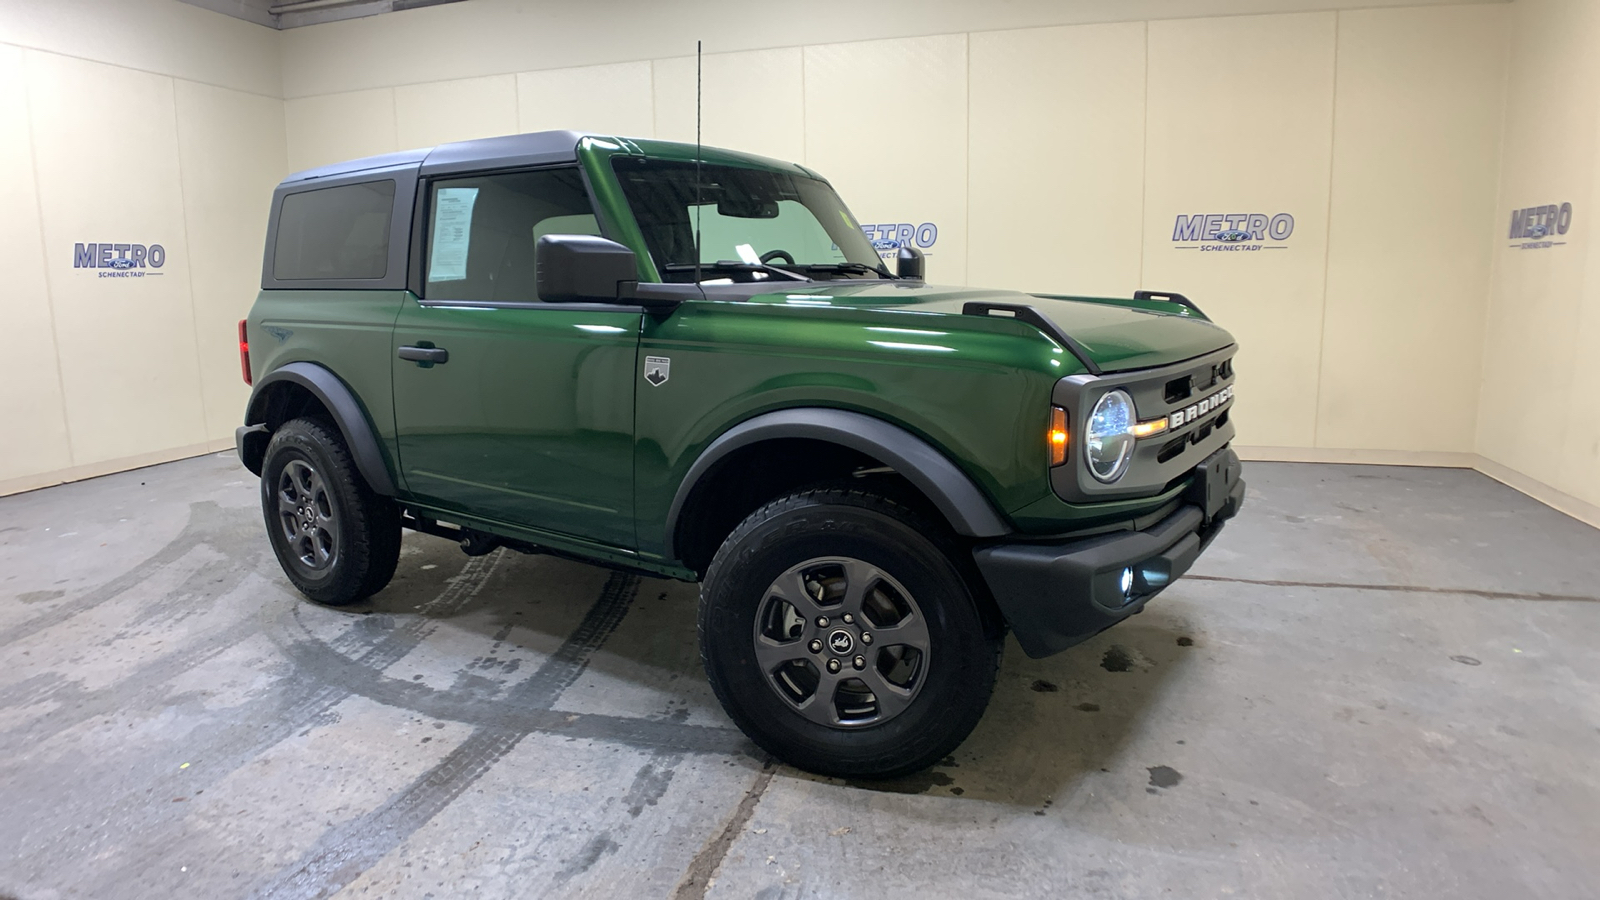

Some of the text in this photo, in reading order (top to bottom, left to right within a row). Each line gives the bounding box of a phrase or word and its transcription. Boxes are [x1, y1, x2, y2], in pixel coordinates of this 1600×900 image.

[1172, 213, 1294, 241] METRO
[1509, 202, 1572, 239] METRO
[832, 223, 938, 250] ETRO
[874, 241, 894, 249] Ford
[73, 243, 165, 268] METRO
